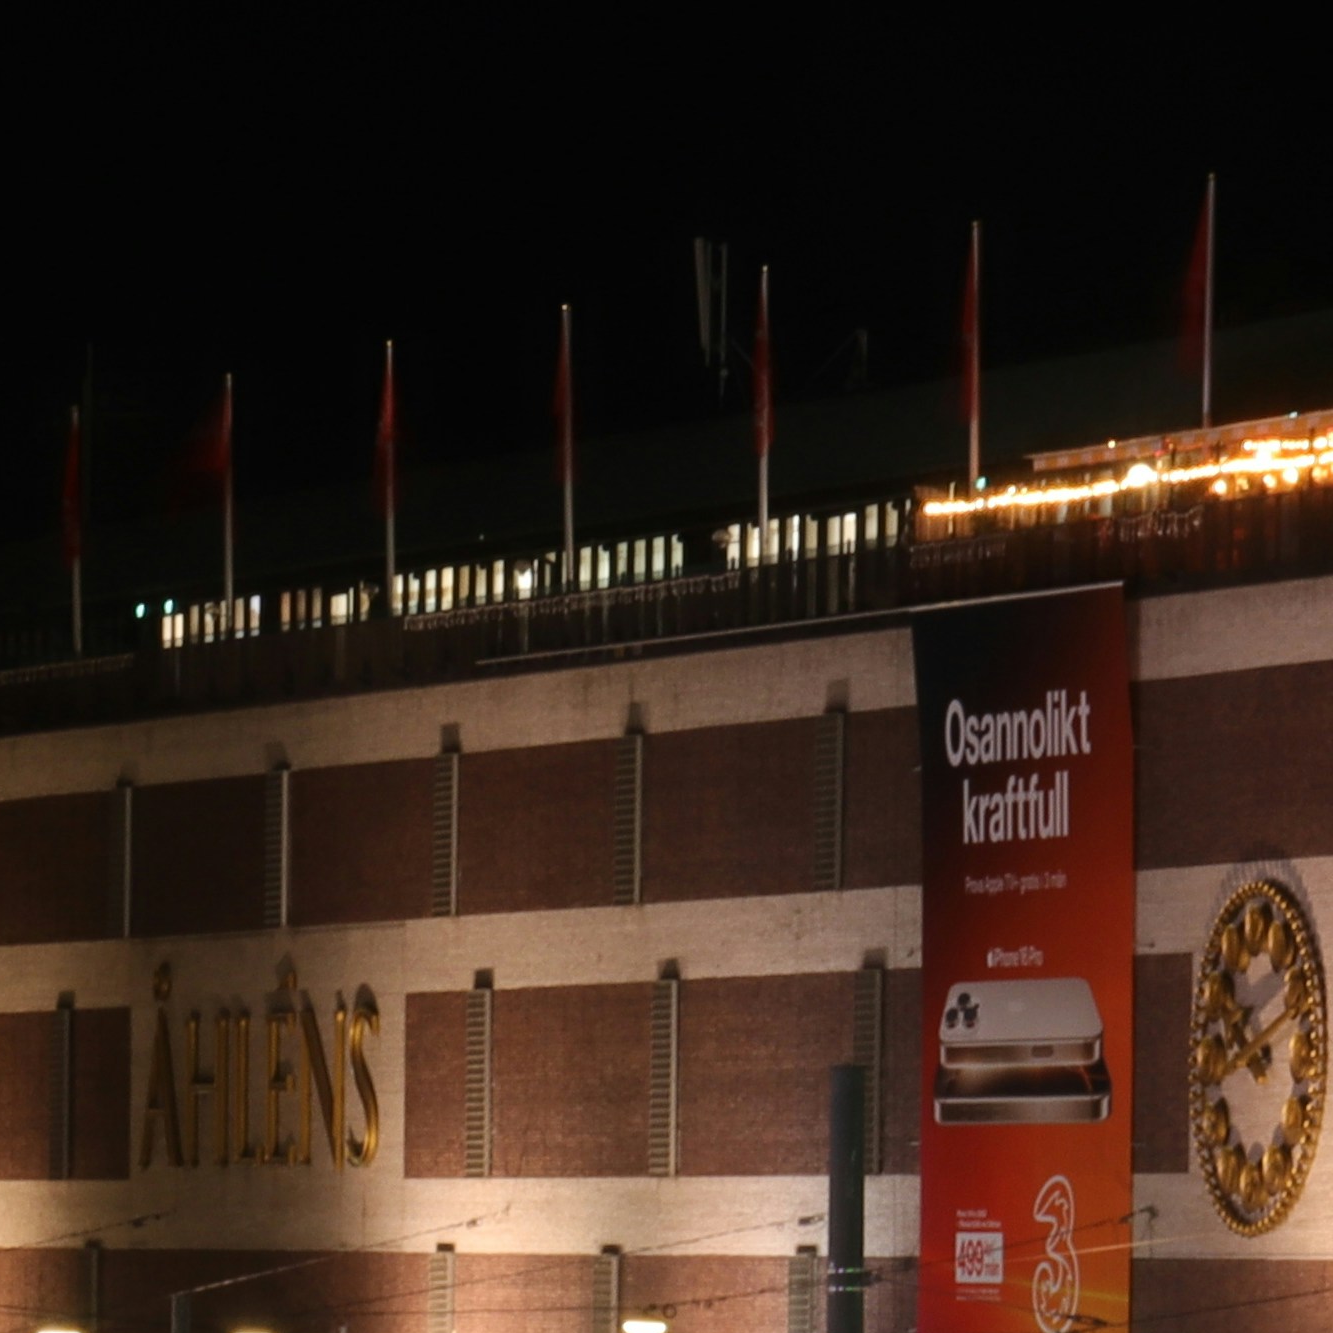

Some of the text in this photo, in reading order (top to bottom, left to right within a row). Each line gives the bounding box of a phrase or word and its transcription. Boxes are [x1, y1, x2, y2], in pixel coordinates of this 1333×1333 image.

[945, 689, 1092, 767] Osannolikt
[963, 770, 1070, 844] kraftfull
[139, 958, 381, 1173] ÅHLÉNS
